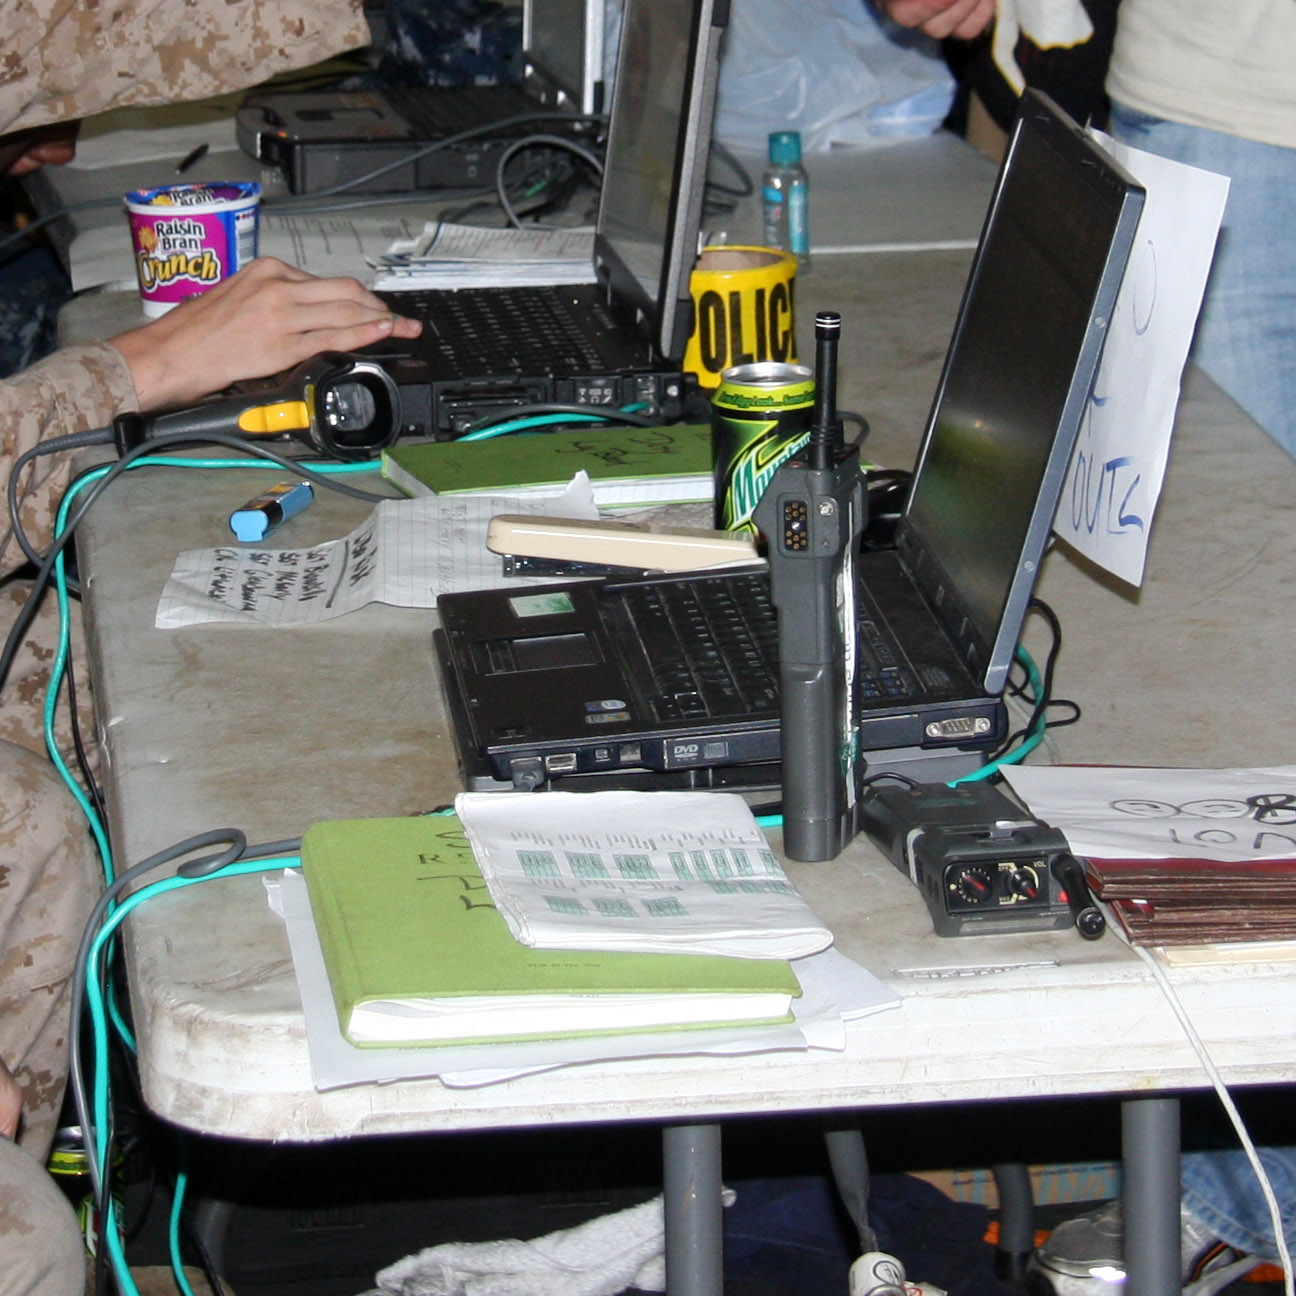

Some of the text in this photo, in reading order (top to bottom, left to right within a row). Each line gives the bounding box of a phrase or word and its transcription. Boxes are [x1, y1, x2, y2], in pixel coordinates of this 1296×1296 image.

[155, 219, 203, 238] Raisin
[162, 237, 198, 251] Bran
[138, 251, 218, 289] Crunch
[699, 276, 797, 373] OLIC
[674, 743, 699, 755] DVD
